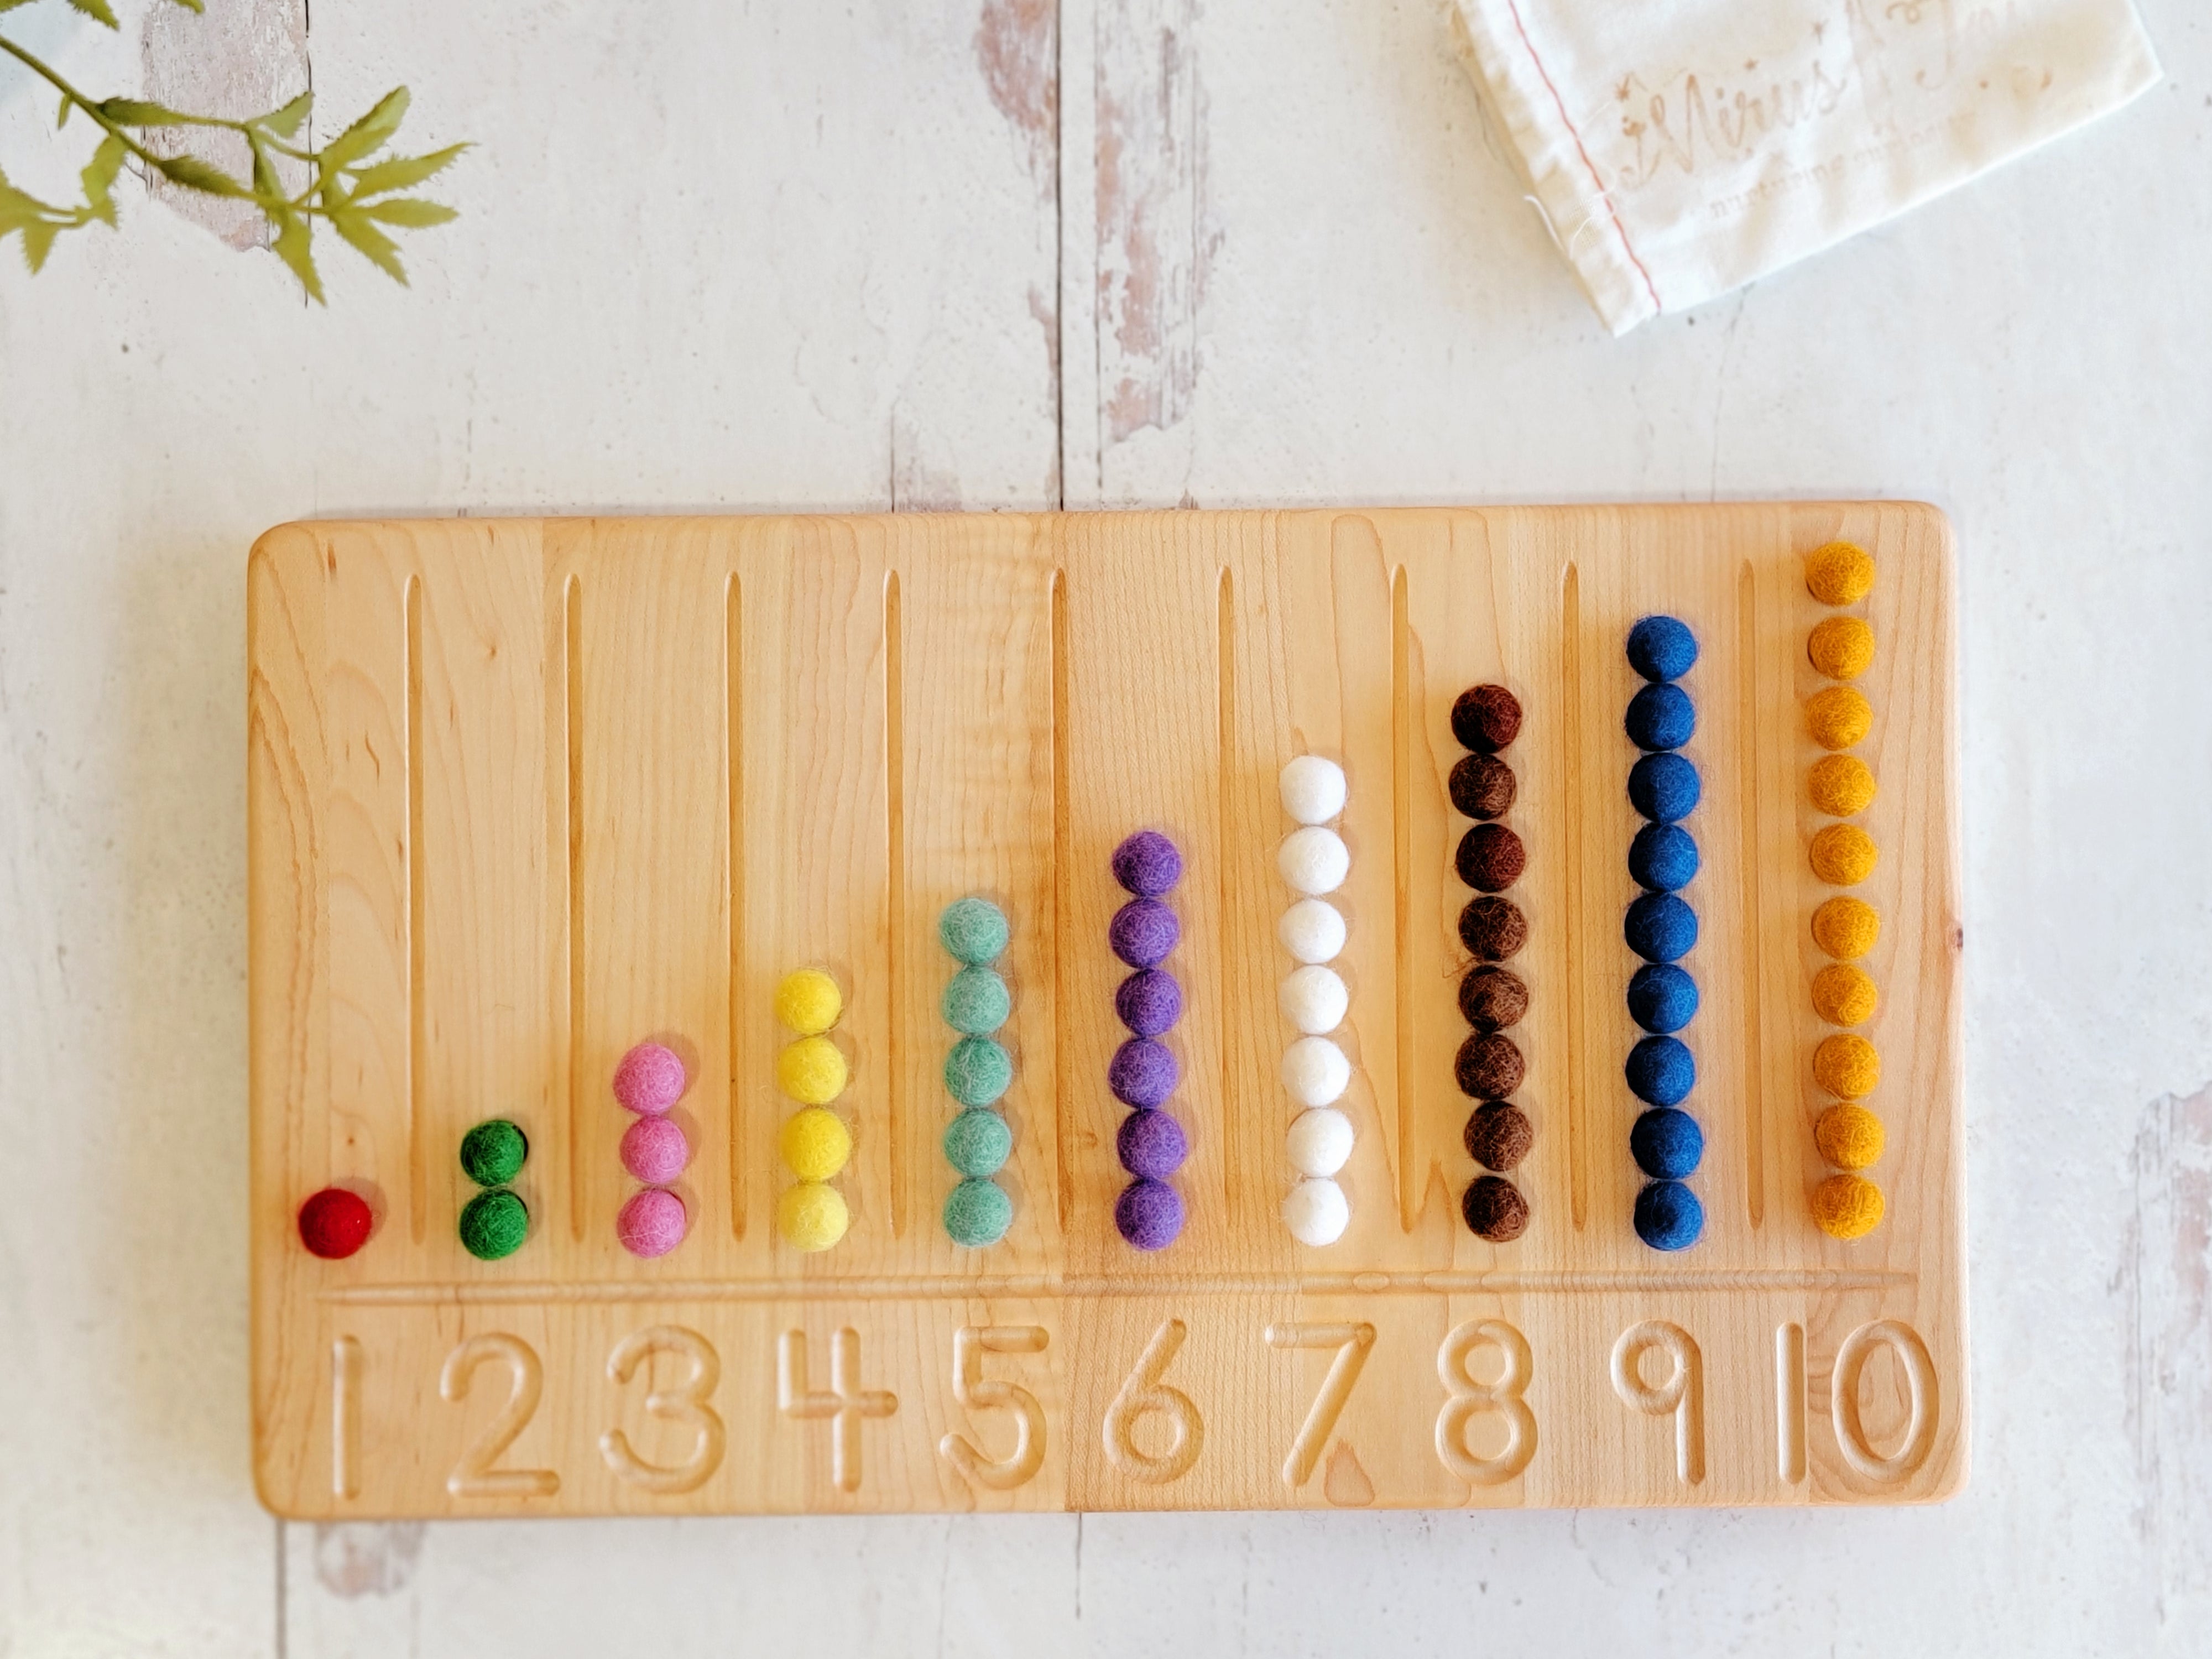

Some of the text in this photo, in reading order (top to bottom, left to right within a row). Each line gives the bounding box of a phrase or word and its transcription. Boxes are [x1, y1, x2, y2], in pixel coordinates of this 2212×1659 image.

[333, 1318, 1939, 1500] 1 2 3 4 5 6 7 8 9 10
